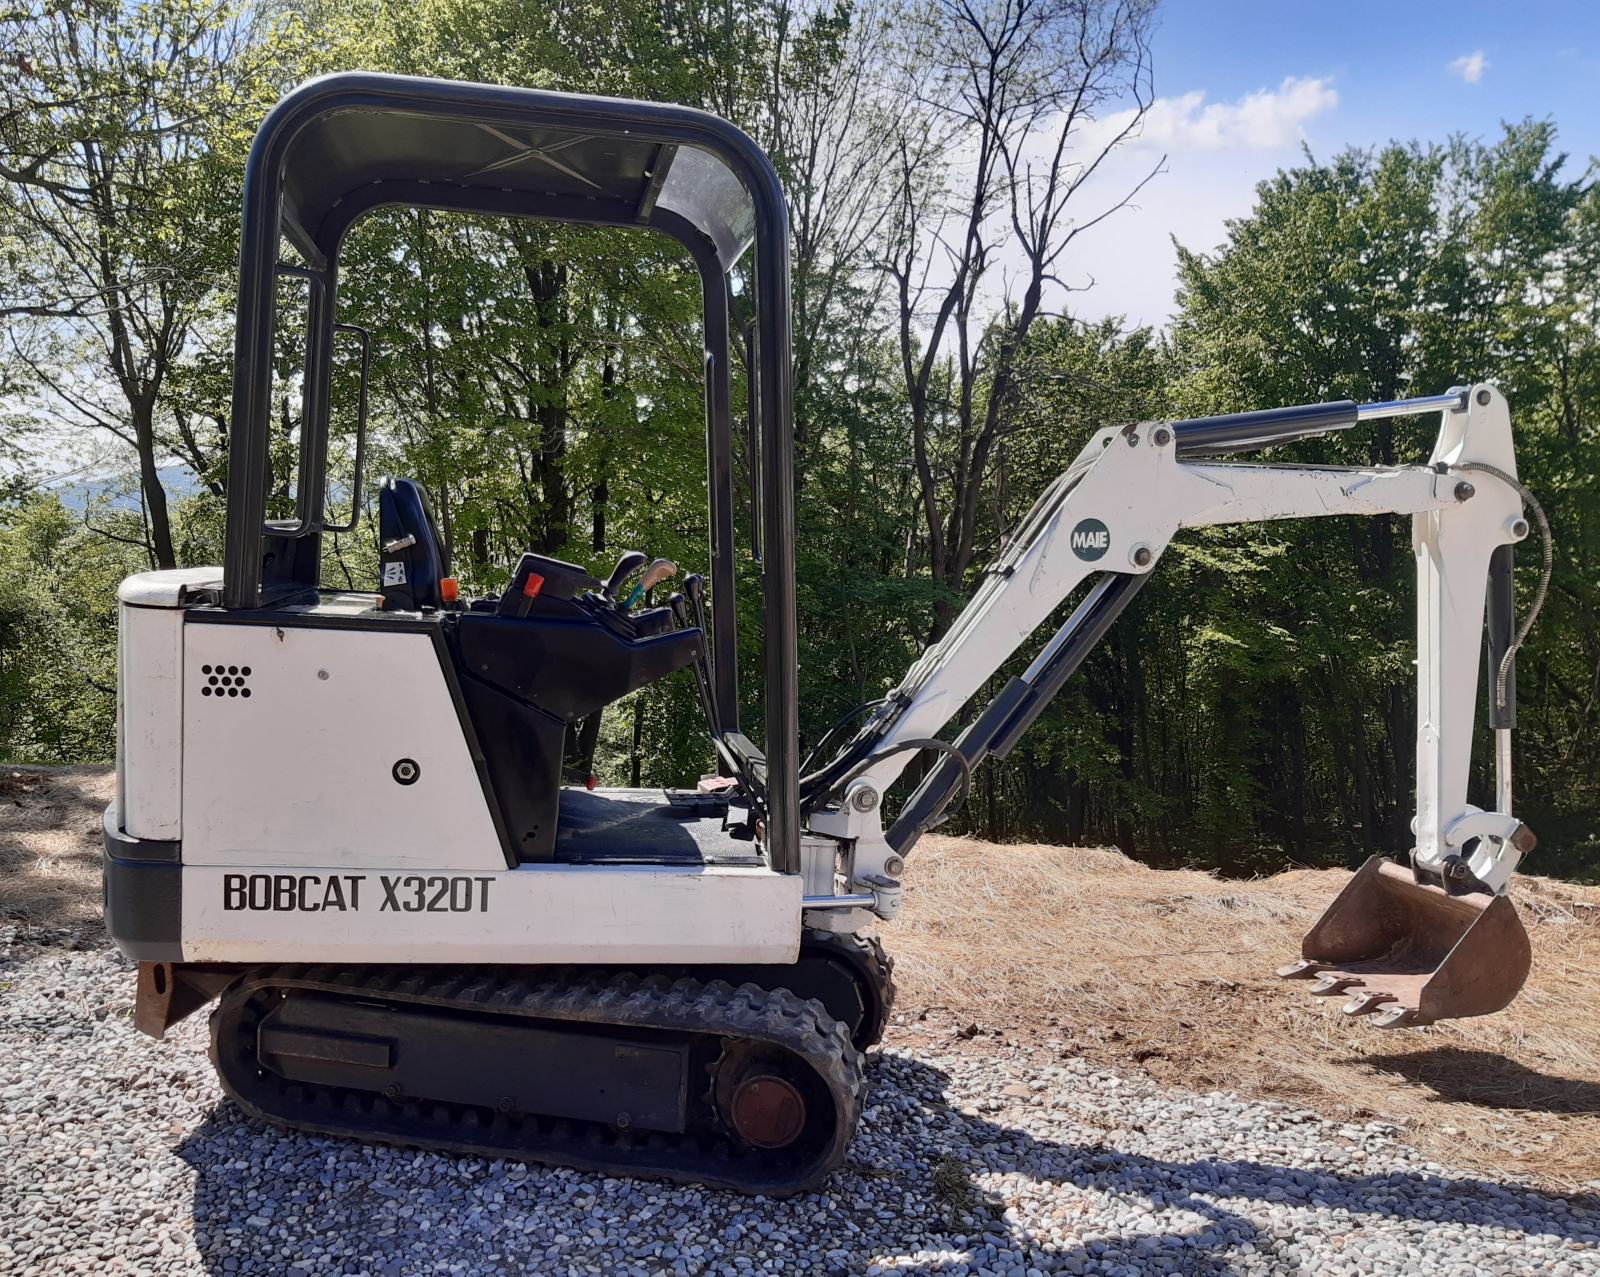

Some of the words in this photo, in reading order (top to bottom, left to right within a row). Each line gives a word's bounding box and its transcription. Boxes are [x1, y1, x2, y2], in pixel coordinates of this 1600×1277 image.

[1072, 531, 1108, 549] MAIE
[223, 874, 366, 912] BOBCAT
[379, 876, 496, 912] X320T
